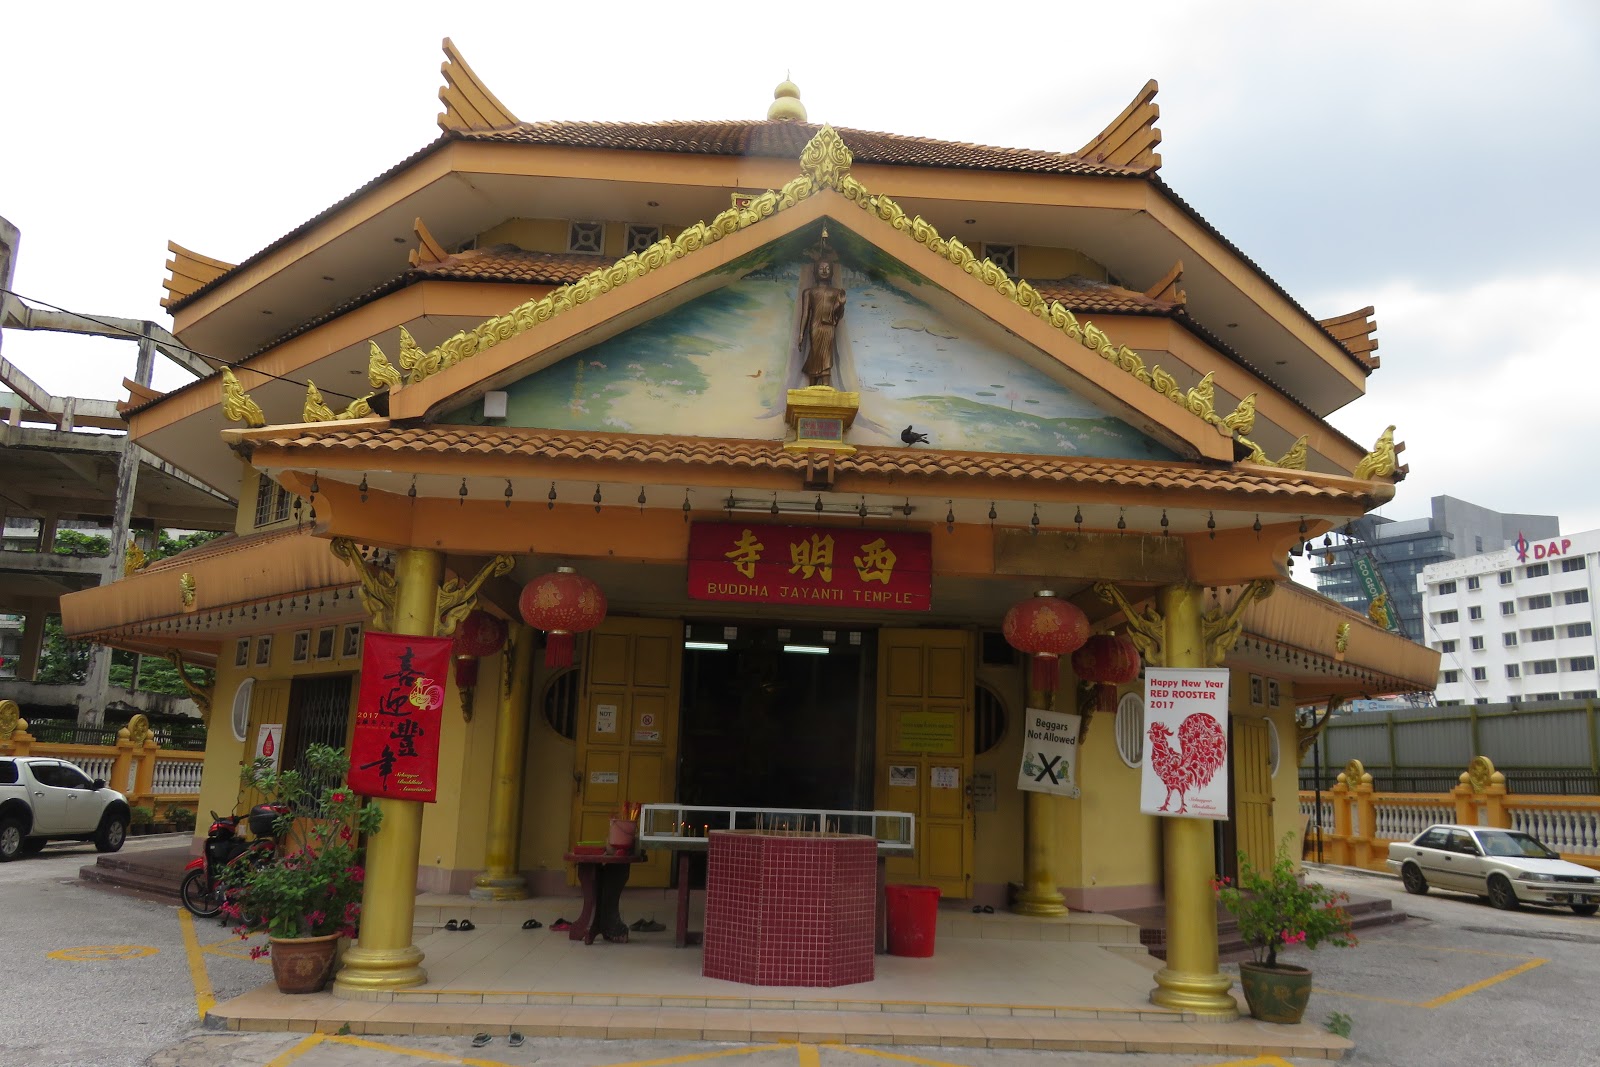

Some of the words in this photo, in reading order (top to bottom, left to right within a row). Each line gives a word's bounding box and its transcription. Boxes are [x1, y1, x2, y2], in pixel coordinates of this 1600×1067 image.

[1534, 539, 1571, 559] DAP
[1358, 560, 1369, 576] ECO
[707, 582, 768, 597] BUDDHA
[780, 586, 843, 600] JAYANTI
[853, 590, 912, 604] TEMPLE
[1150, 678, 1178, 688] Happy
[1181, 679, 1201, 688] New
[1204, 680, 1224, 688] Year
[1150, 690, 1169, 698] RED
[1172, 690, 1216, 700] ROOSTER
[1150, 700, 1174, 709] 2017
[1036, 718, 1068, 731] Beggars
[1027, 729, 1042, 739] Not
[1043, 732, 1076, 745] Allowed
